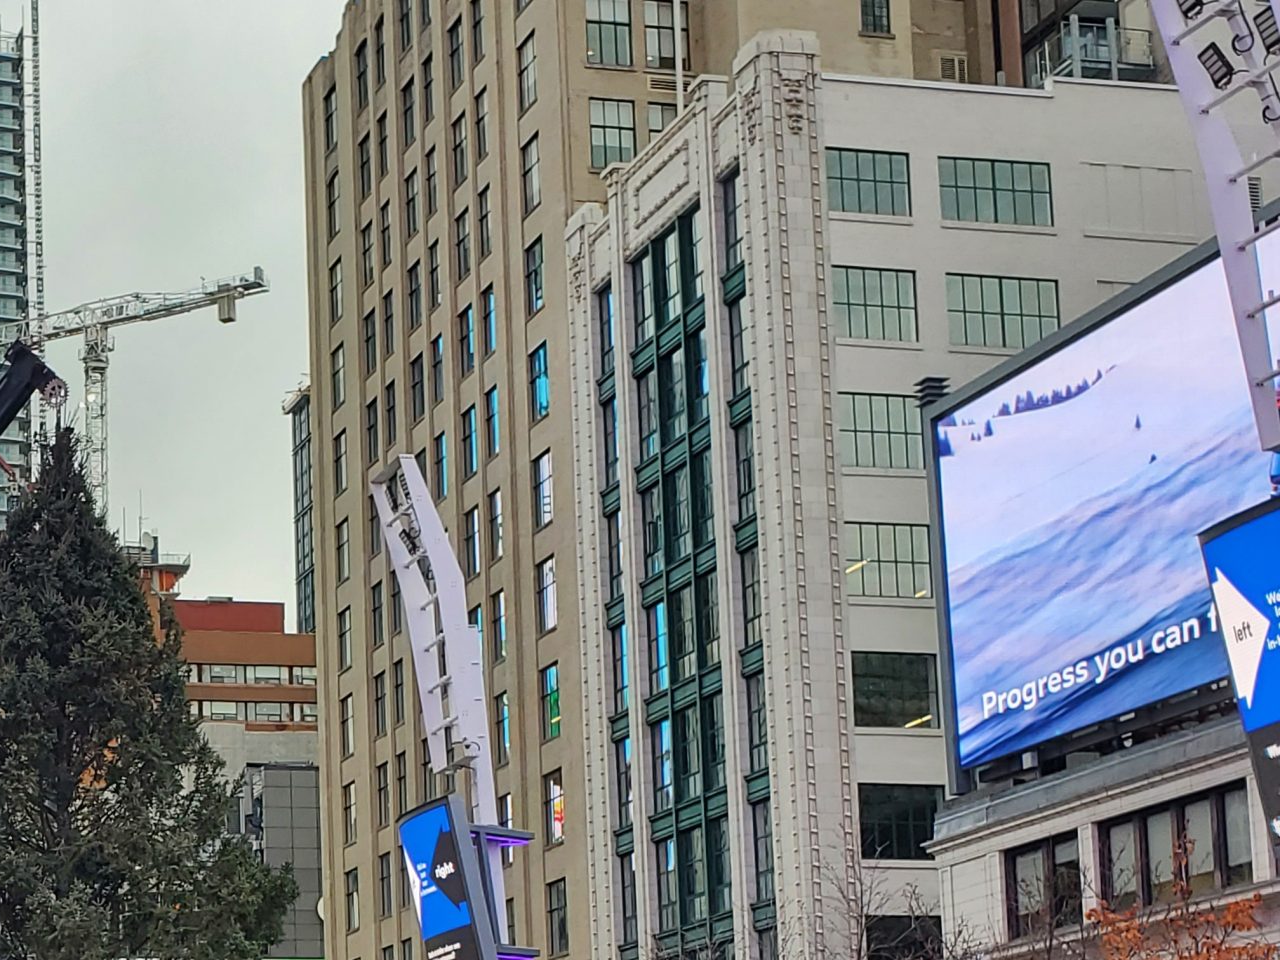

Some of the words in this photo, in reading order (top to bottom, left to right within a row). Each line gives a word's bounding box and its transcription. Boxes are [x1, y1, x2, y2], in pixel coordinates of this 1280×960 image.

[1233, 621, 1253, 644] left
[982, 658, 1089, 719] Progress
[1093, 639, 1144, 684] you
[1151, 616, 1200, 654] can
[435, 862, 455, 878] right
